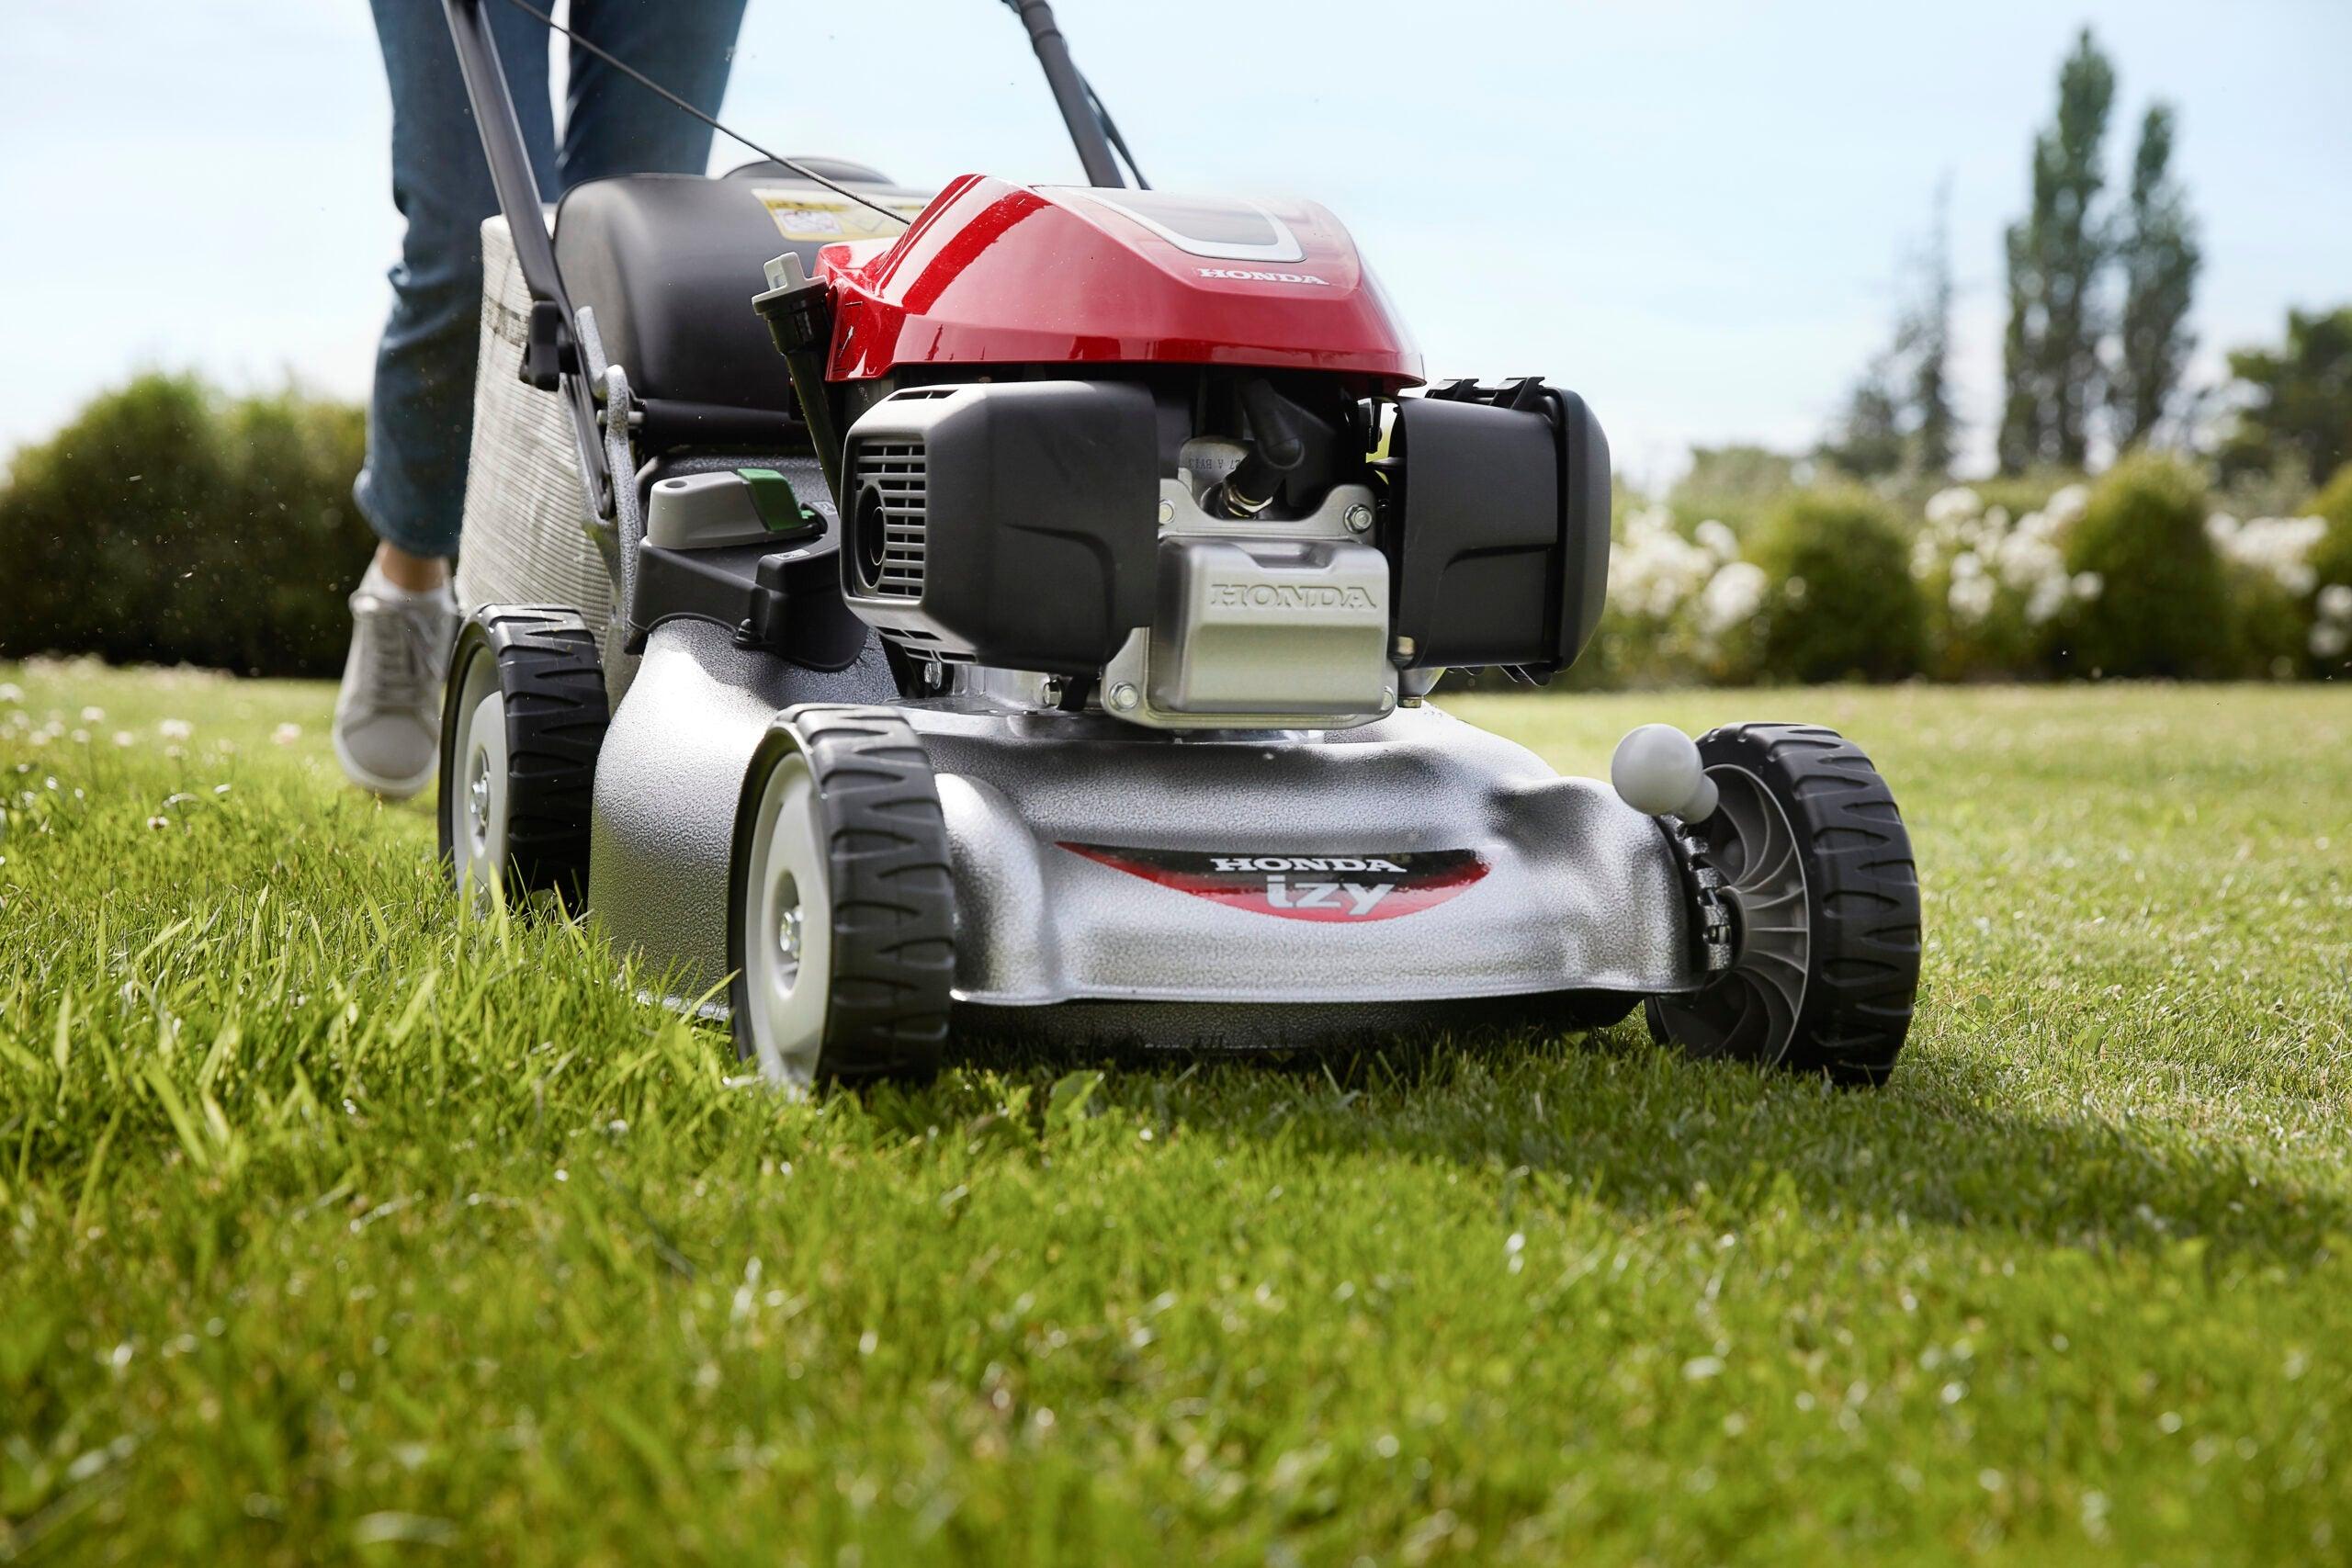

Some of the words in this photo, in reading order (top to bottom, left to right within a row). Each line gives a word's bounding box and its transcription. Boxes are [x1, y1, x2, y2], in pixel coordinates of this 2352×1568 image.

[1198, 267, 1329, 286] HONDA
[1211, 584, 1377, 609] HONDA
[1210, 858, 1408, 873] HONDA
[1267, 874, 1395, 916] izy
